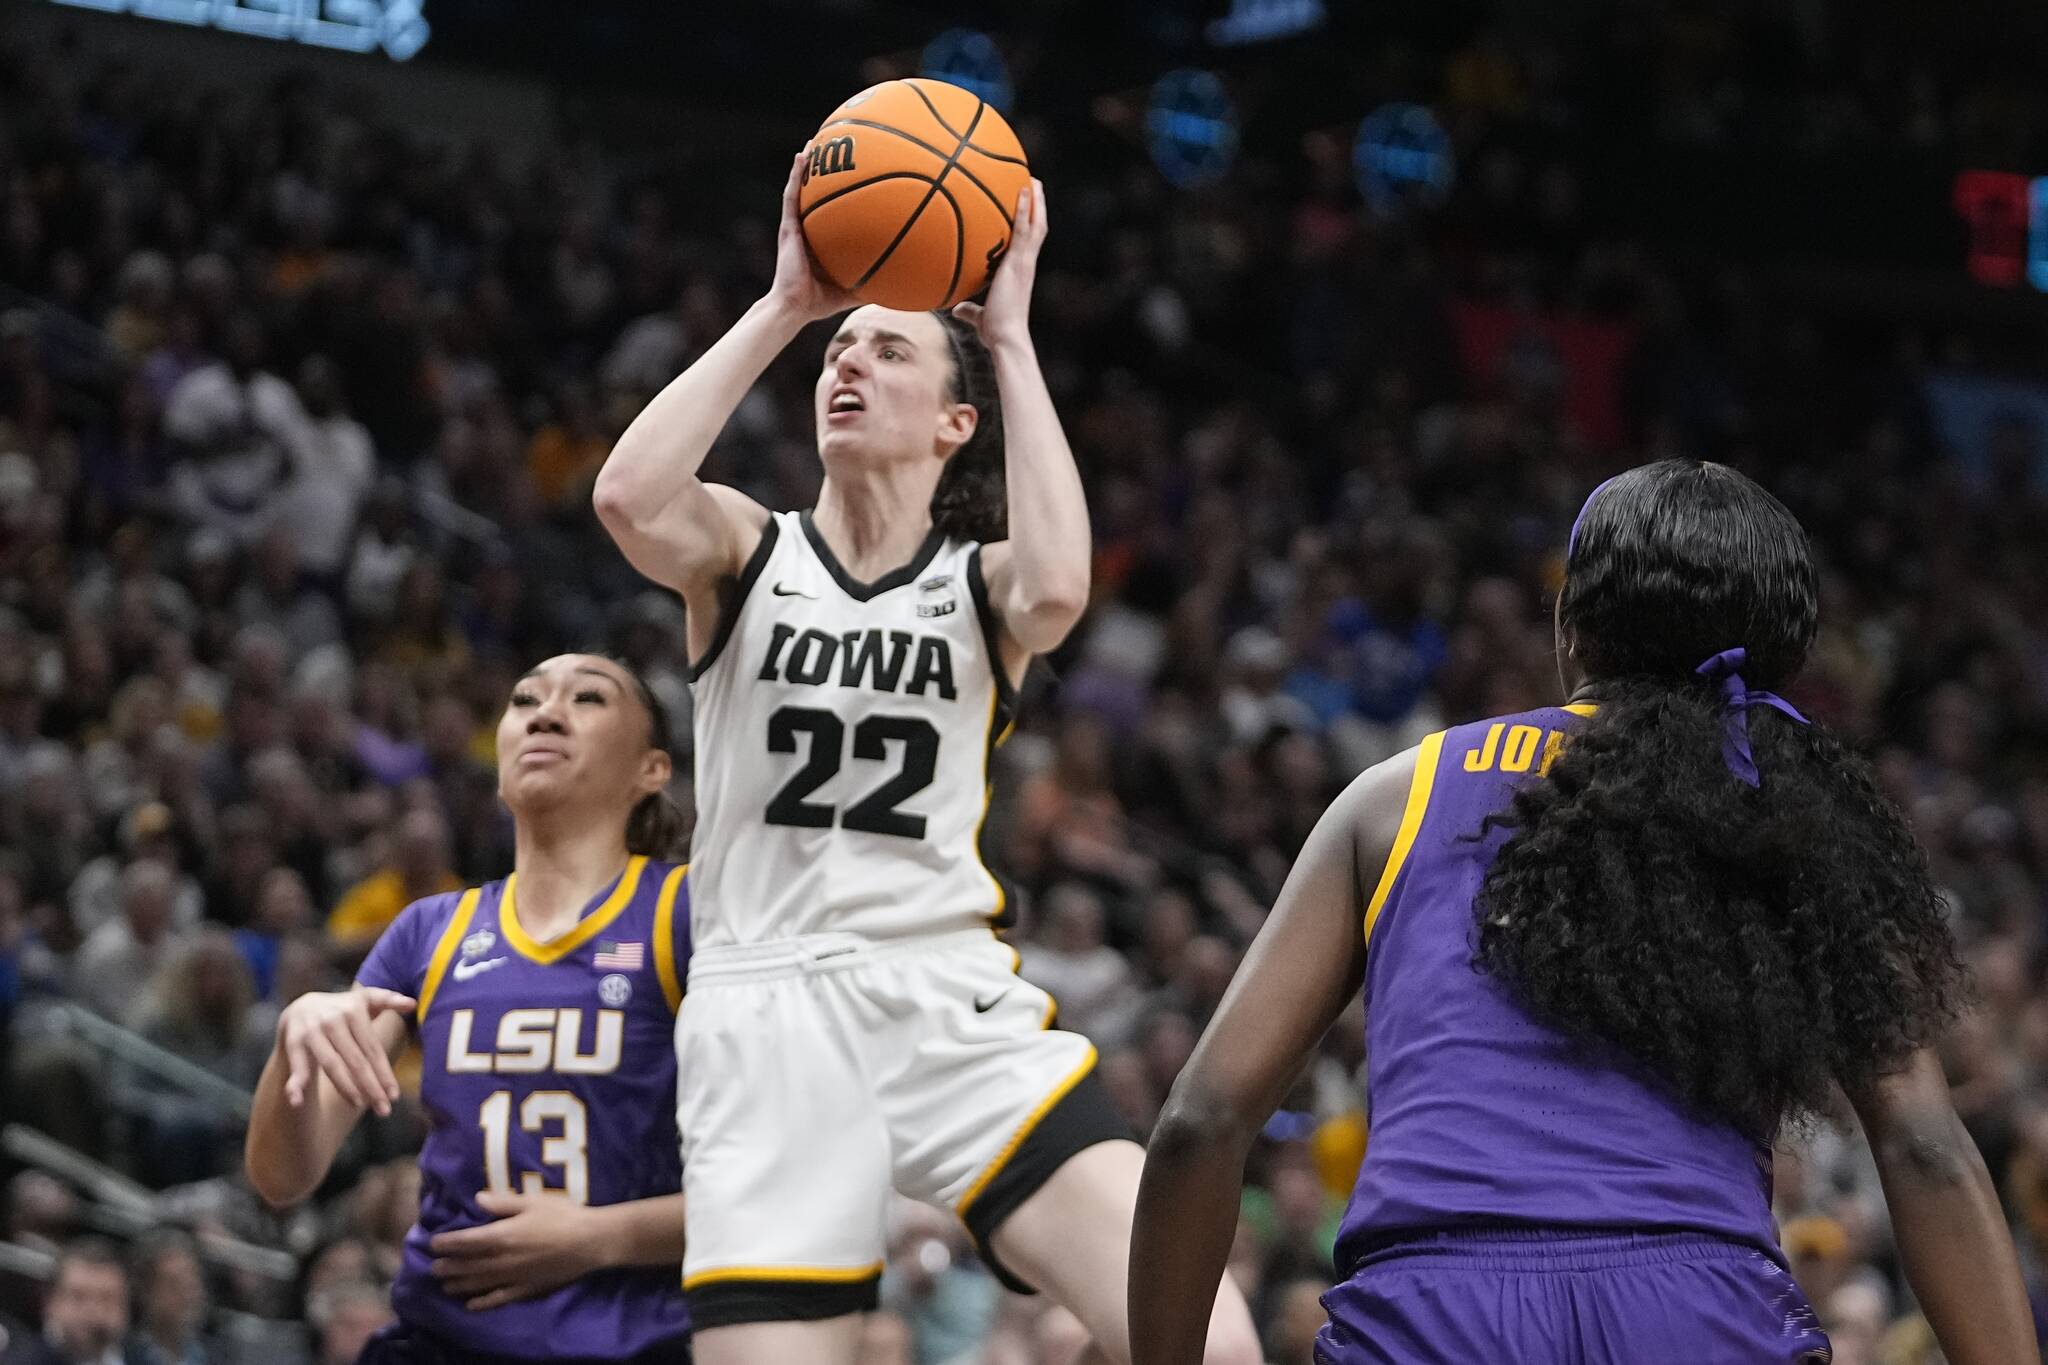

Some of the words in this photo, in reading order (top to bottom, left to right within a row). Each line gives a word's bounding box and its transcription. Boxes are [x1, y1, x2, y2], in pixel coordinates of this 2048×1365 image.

[757, 622, 957, 702] IOWA
[765, 704, 940, 840] 22
[446, 1007, 625, 1075] LSU
[479, 1090, 589, 1207] 13
